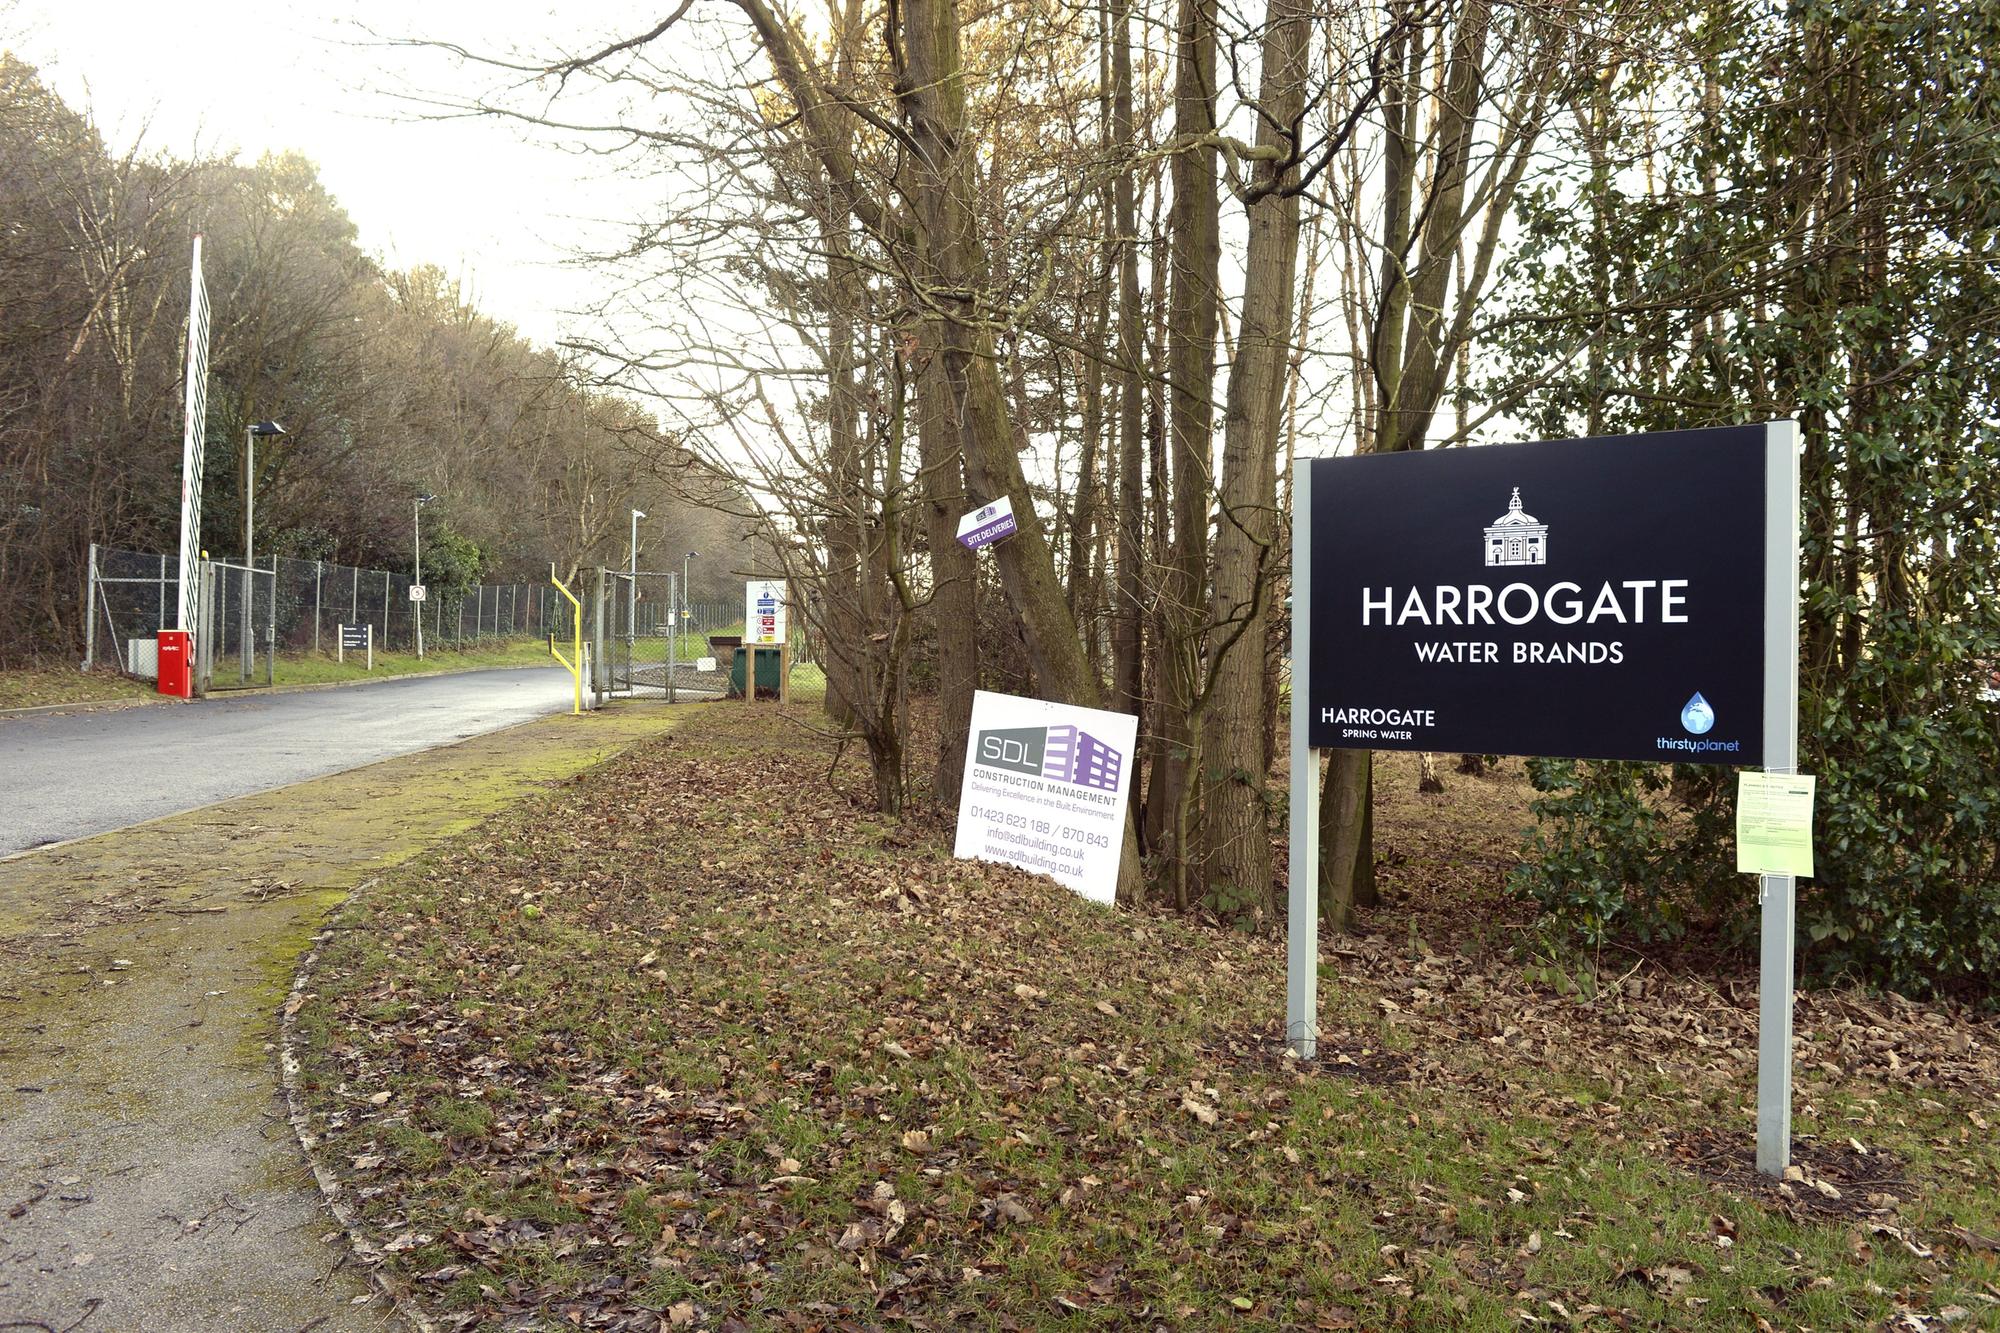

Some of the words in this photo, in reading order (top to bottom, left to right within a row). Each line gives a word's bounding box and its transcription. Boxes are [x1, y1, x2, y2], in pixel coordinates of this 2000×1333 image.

[967, 534, 981, 546] SITE
[981, 519, 1014, 540] DELIVERIES
[1362, 579, 1689, 626] HARROGATE
[1414, 641, 1500, 664] WATER
[1512, 640, 1624, 664] BRANDS
[1321, 707, 1436, 727] HARROGATE
[1342, 729, 1378, 739] SPRING
[1380, 730, 1413, 741] WATER
[1656, 735, 1740, 753] thirstyplanet
[983, 736, 1039, 768] SDL
[971, 781, 1001, 797] Delivering
[1002, 788, 1036, 803] Excellence
[1043, 797, 1055, 807] the
[1056, 799, 1071, 812] Built
[1071, 803, 1115, 821] Environment
[973, 768, 1045, 791] CONSTRUCTION
[1047, 783, 1117, 808] MANAGEMENT
[970, 805, 1004, 823] 01423
[1006, 813, 1027, 829] 623
[1030, 819, 1050, 834] 188
[1051, 825, 1061, 837] /
[1062, 826, 1085, 842] 870
[1086, 833, 1109, 848] 843
[986, 826, 1085, 861] info@sdlbuilding.co.uk
[985, 843, 1084, 878] www.sdlbuilding.co.uk
